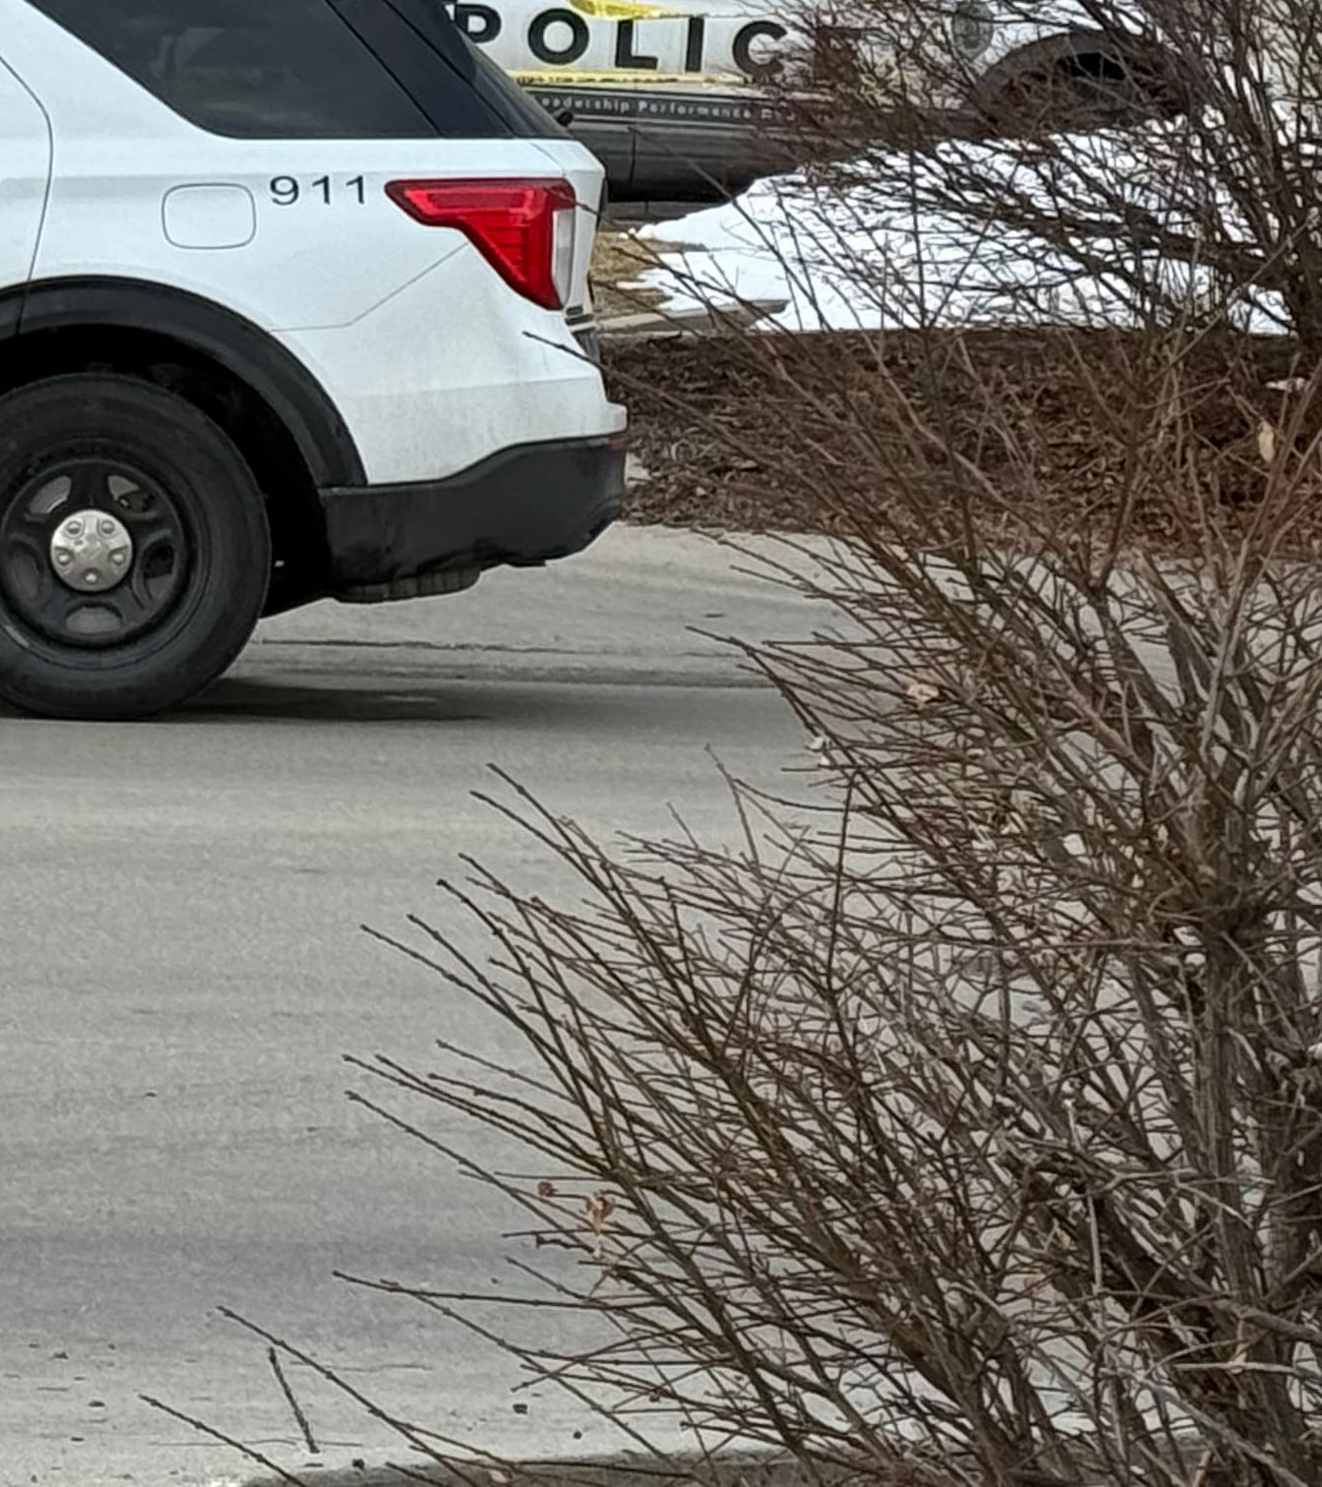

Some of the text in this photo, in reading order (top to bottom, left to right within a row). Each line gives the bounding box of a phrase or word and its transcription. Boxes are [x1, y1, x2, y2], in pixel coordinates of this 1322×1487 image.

[455, 2, 857, 81] POLIC
[539, 95, 630, 114] eadership
[269, 174, 365, 206] 911
